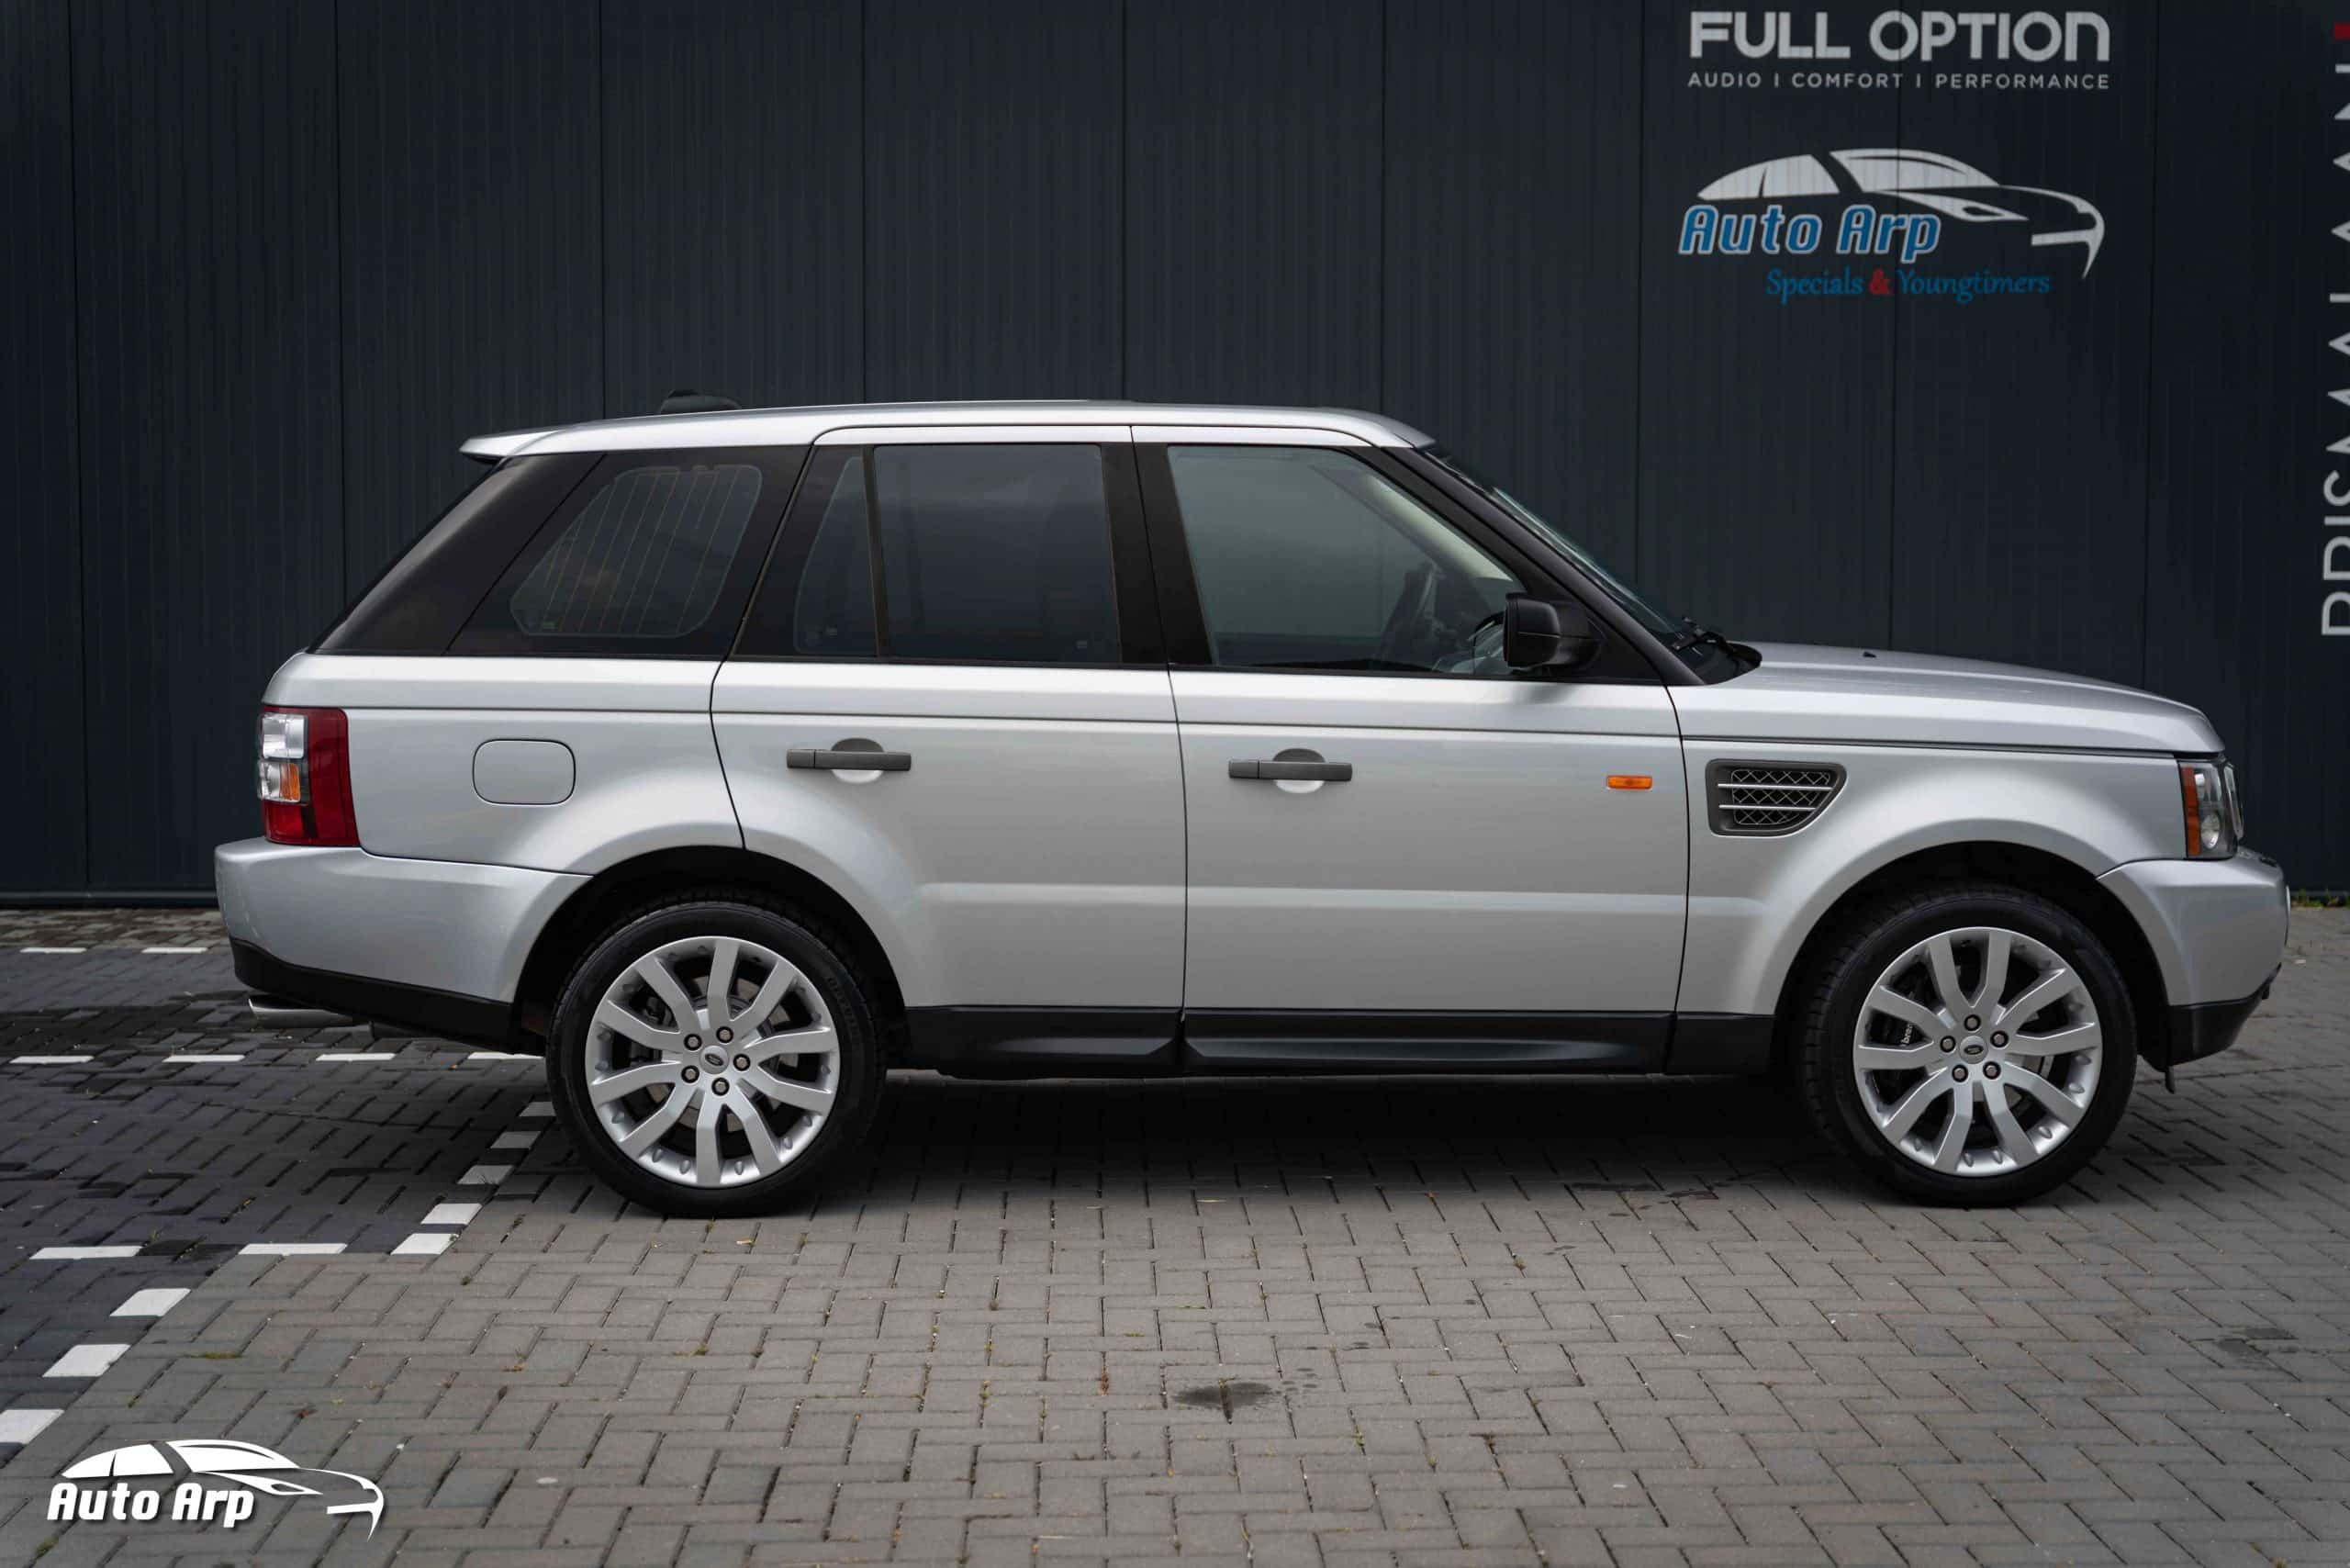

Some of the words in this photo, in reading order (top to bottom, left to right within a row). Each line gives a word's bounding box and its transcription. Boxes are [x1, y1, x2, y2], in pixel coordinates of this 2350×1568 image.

[1689, 11, 1852, 60] FULL
[1869, 10, 2110, 62] OPTION
[1687, 72, 1762, 89] AUDIO
[1791, 72, 1904, 89] COMFORT
[1935, 72, 2109, 90] PERFORMANCE
[1679, 205, 1822, 254] Auto
[1836, 205, 1941, 263] Arp
[1765, 267, 1863, 305] Specials
[1869, 268, 1892, 296] &
[1896, 268, 2051, 305] Youngtimers
